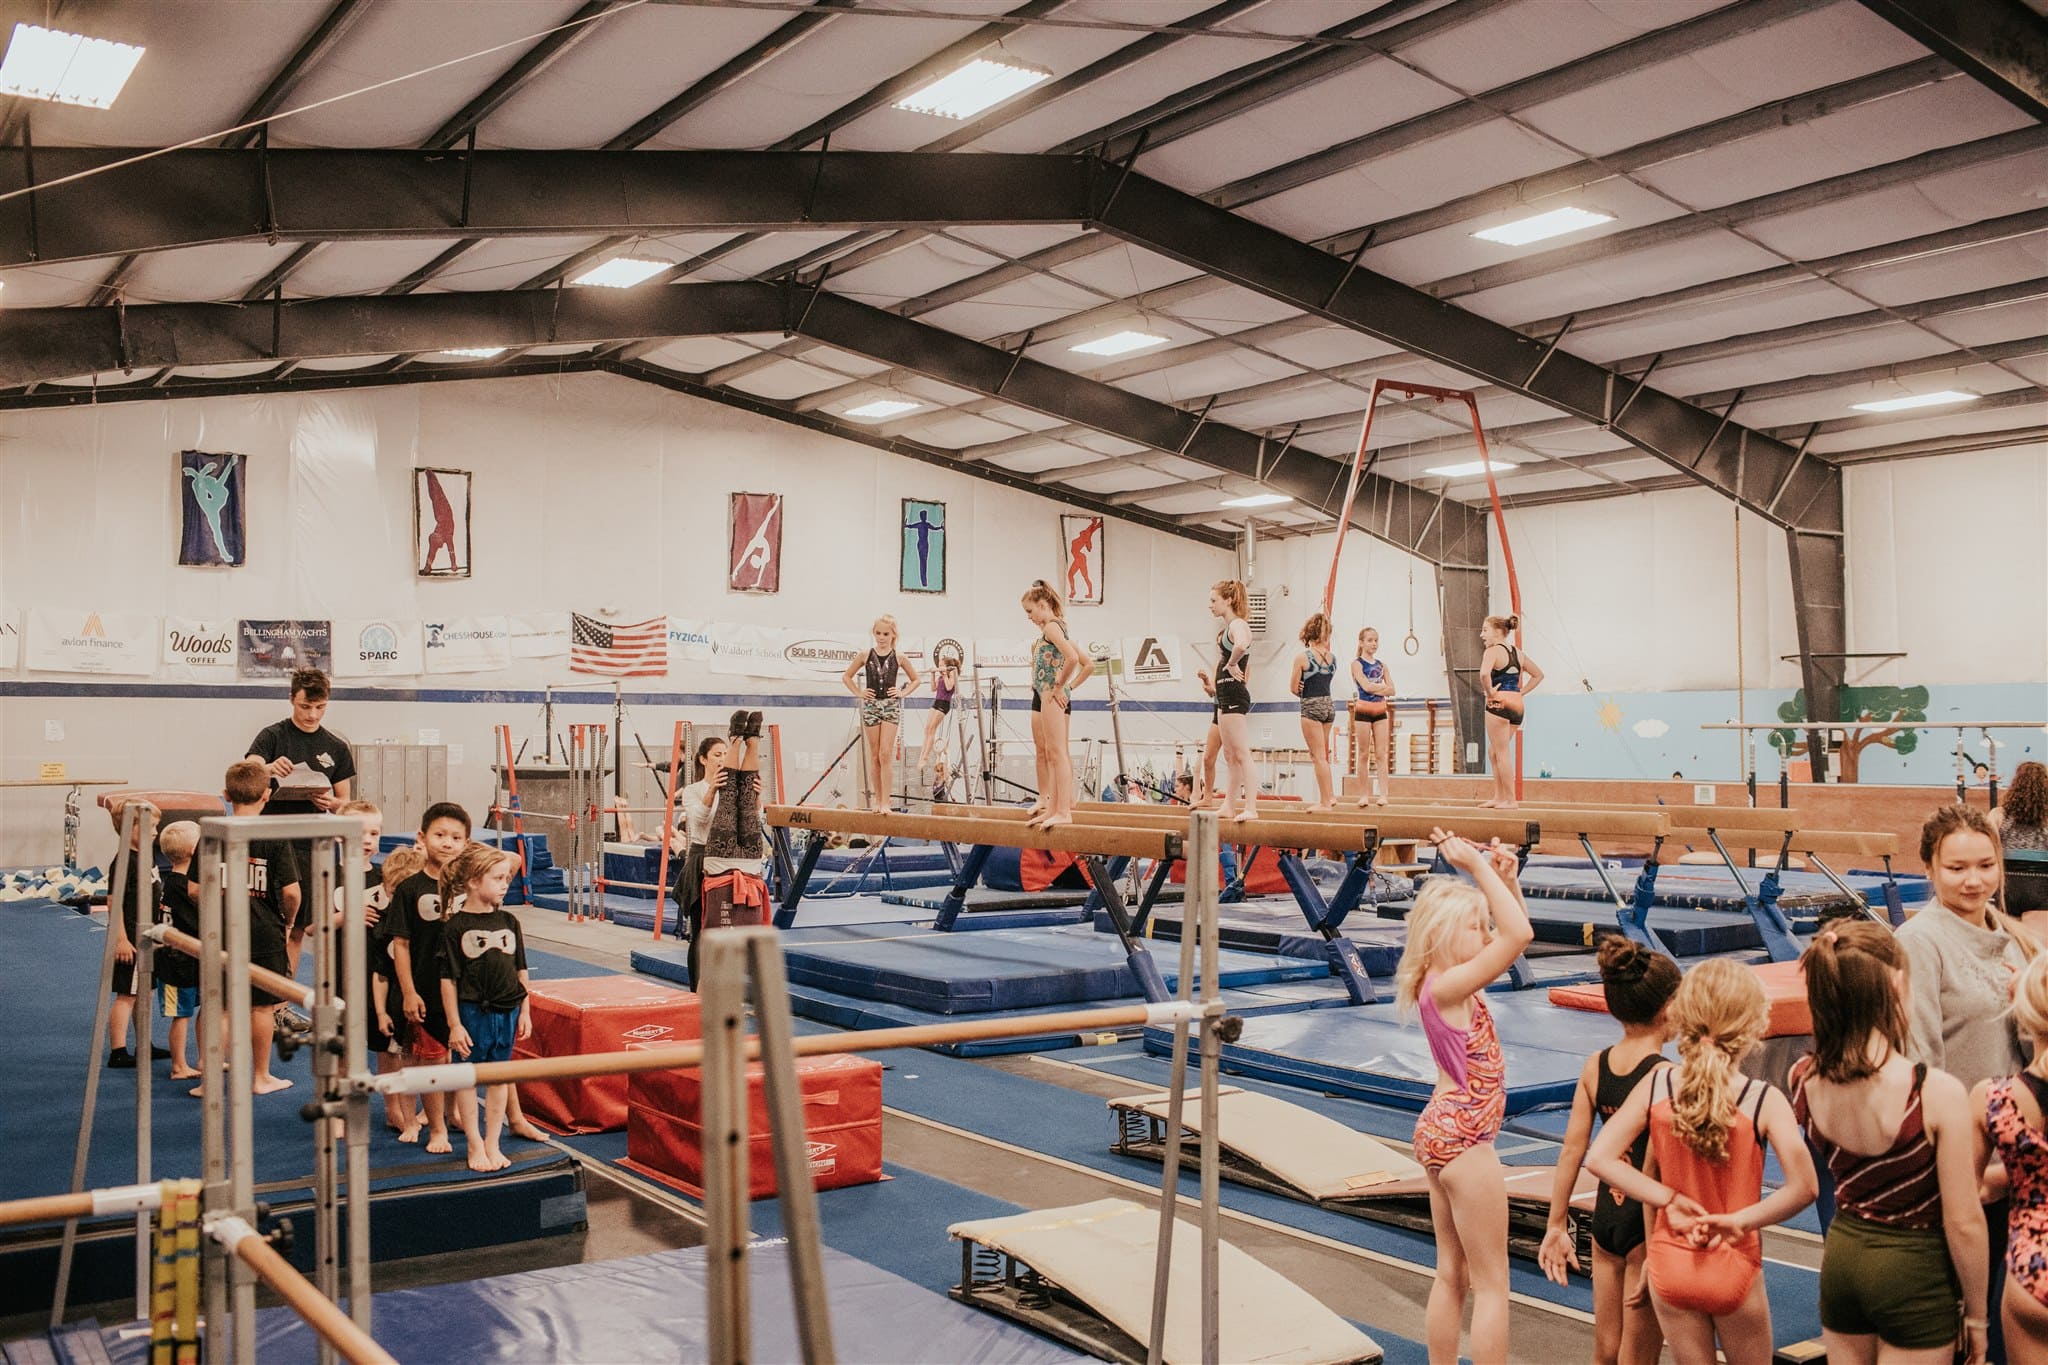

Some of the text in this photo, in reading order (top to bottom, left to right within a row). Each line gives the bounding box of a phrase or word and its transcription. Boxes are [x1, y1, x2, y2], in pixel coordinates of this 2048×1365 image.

[243, 628, 297, 637] BELLINGHAM
[297, 628, 328, 638] YACHTS
[669, 631, 709, 644] FYZICAL
[90, 638, 124, 649] finance
[170, 631, 232, 653] Woods
[359, 651, 398, 661] SPARC
[720, 645, 782, 659] Waldorf School
[791, 647, 816, 658] SOLIS
[186, 656, 216, 664] COFFEE
